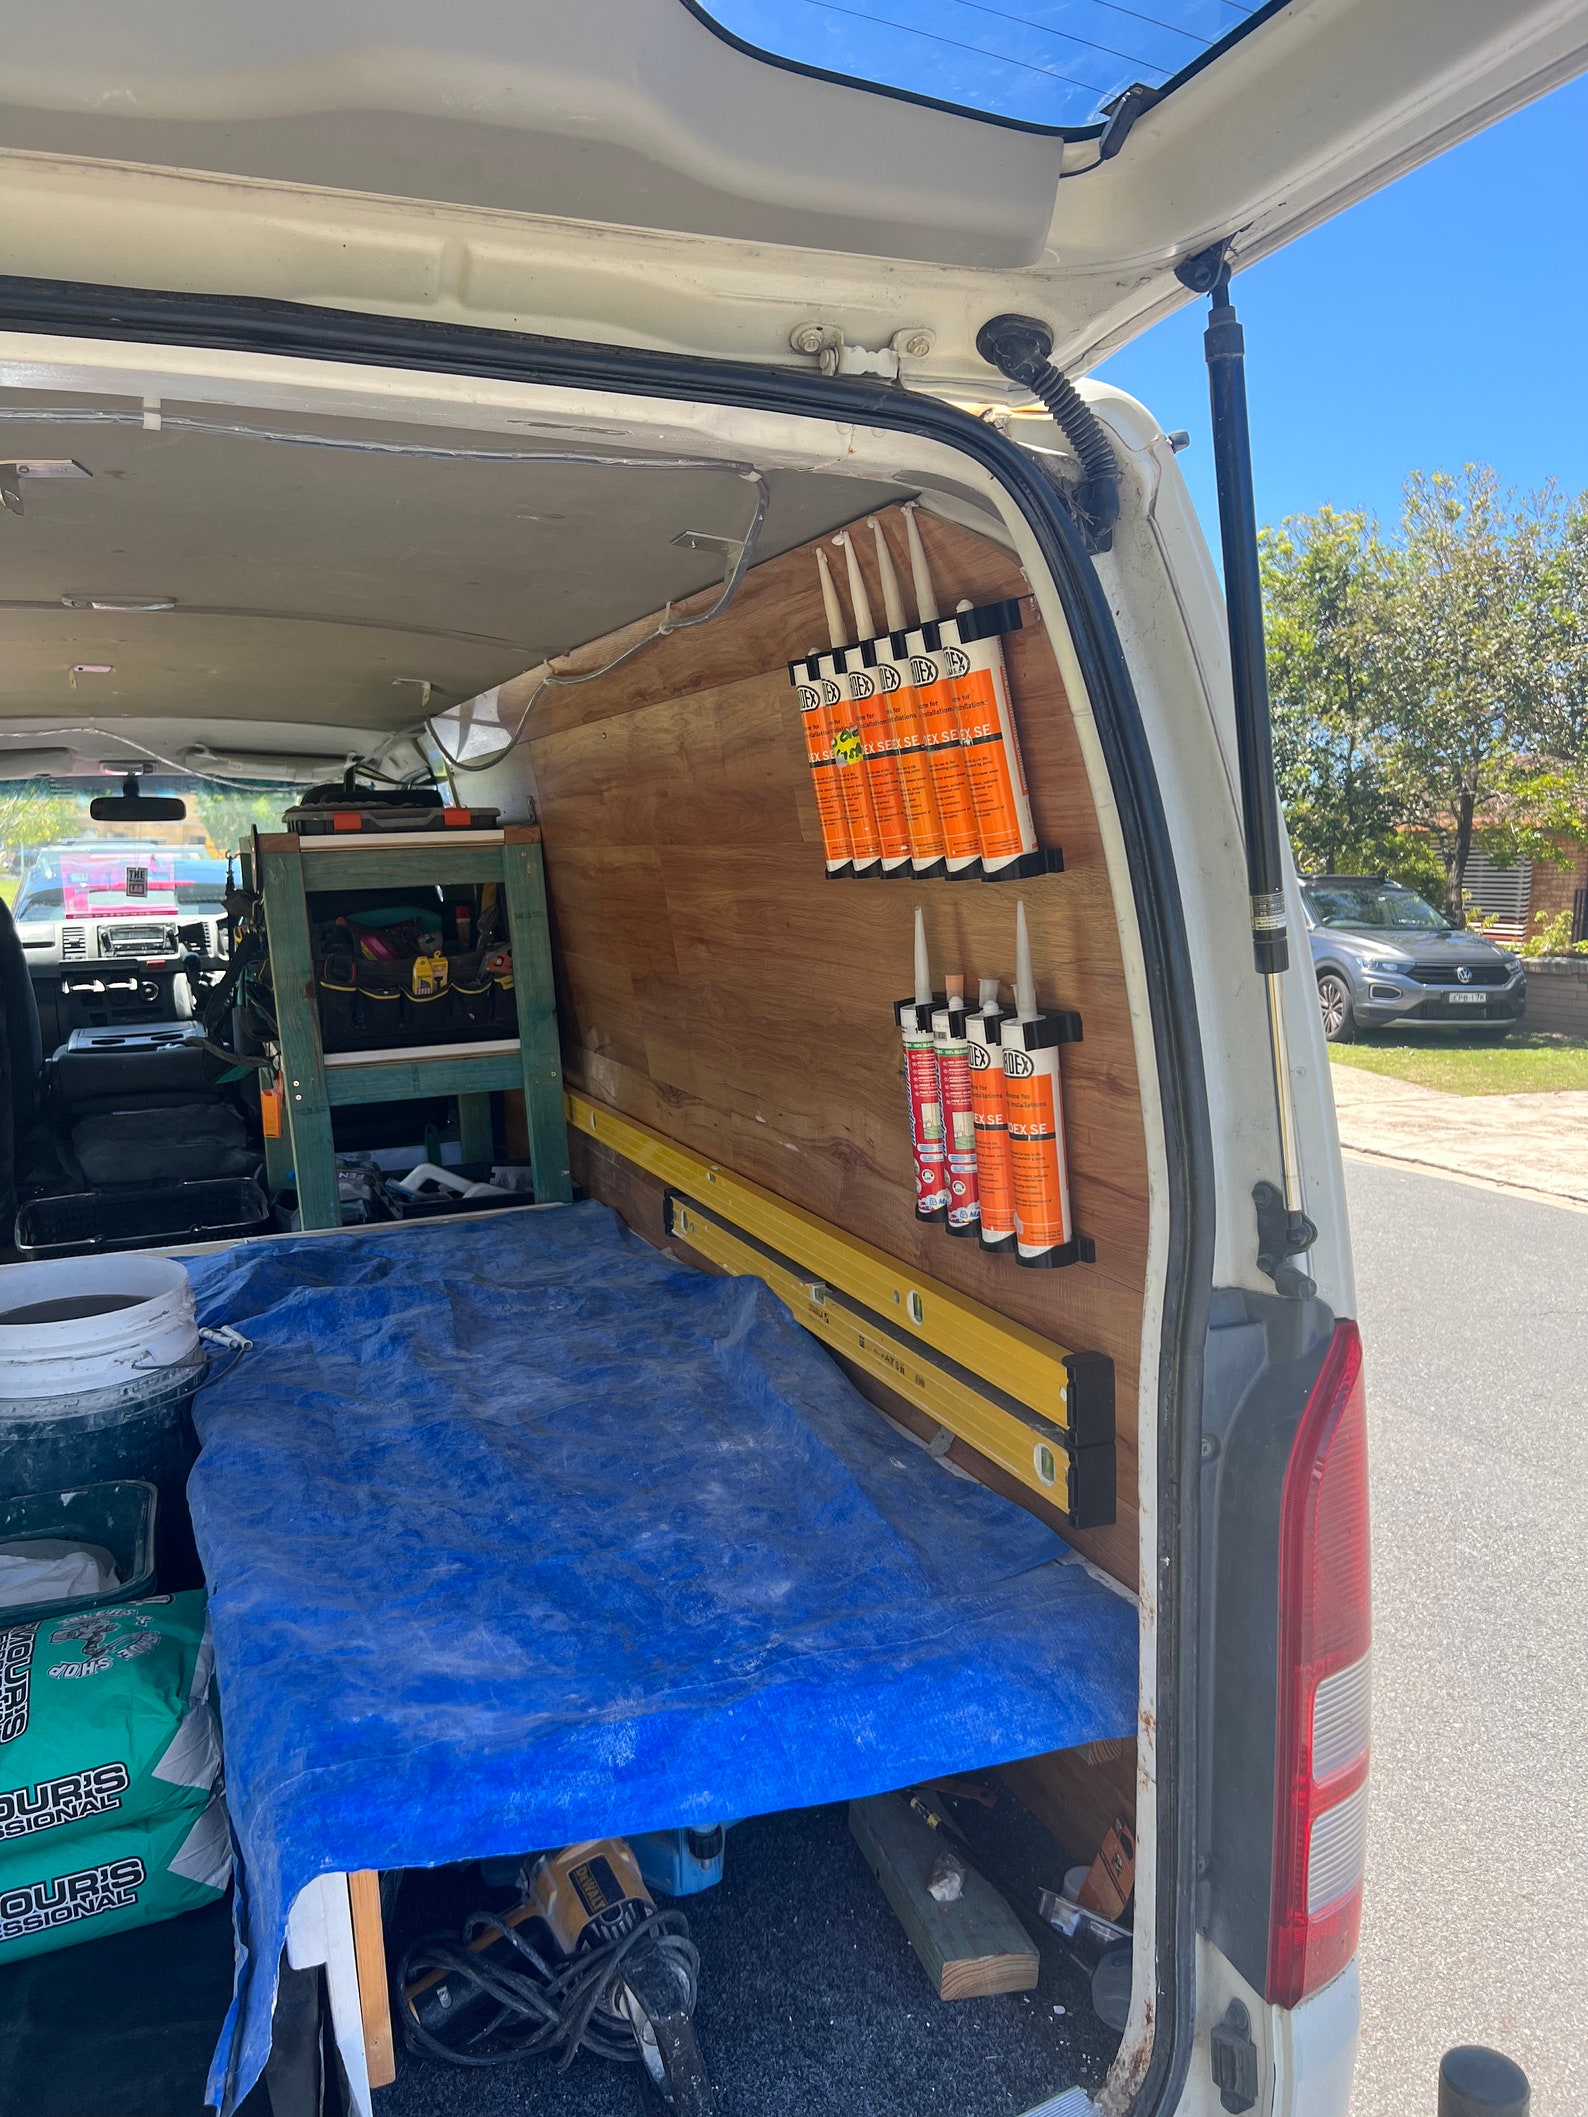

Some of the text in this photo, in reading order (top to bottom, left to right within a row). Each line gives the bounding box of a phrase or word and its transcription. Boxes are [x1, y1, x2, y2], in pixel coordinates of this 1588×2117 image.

[941, 729, 959, 742] SE
[973, 724, 992, 738] SE
[877, 740, 892, 752] SE
[903, 735, 920, 748] SE
[129, 869, 145, 880] THE
[987, 1114, 1004, 1125] SE
[1030, 1123, 1048, 1134] SE
[48, 1657, 113, 1680] SHOP
[0, 1796, 120, 1839] SIONAL
